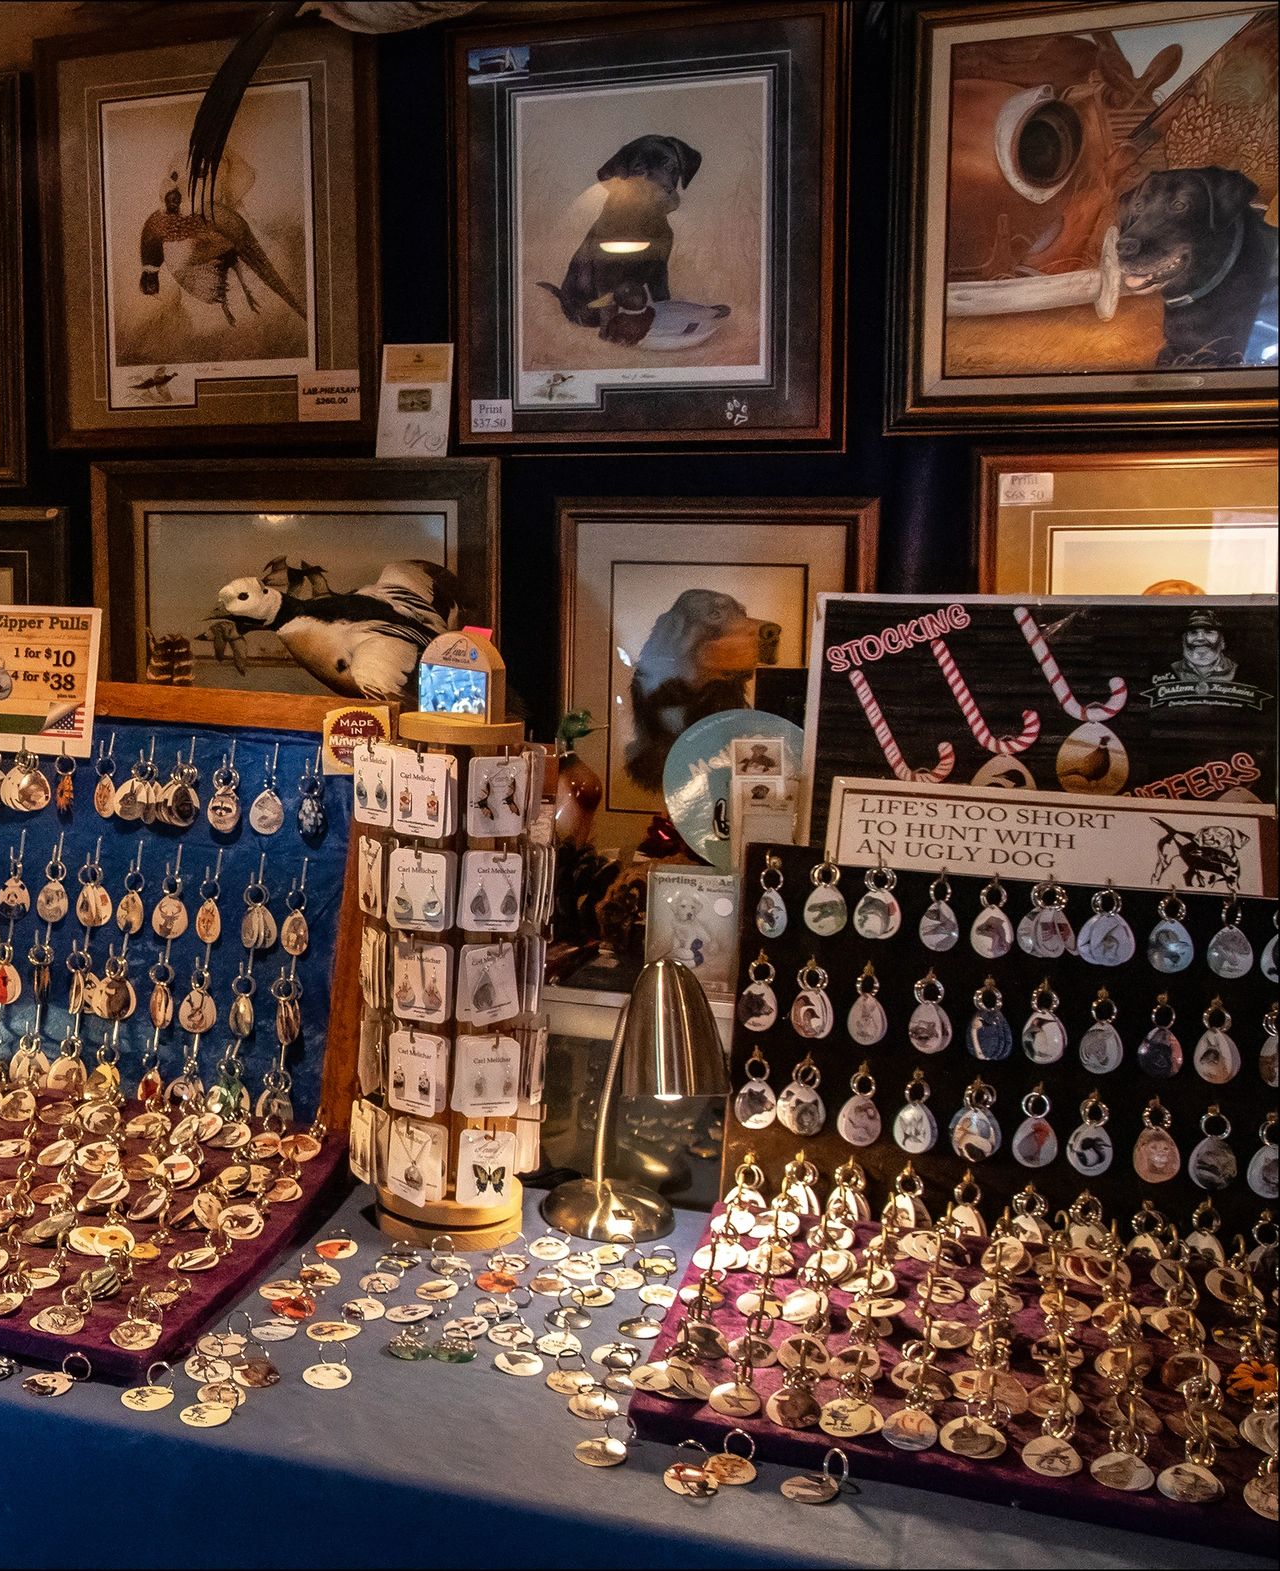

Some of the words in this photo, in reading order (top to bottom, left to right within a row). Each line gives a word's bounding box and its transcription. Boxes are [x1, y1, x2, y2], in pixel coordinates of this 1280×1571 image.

[478, 404, 503, 414] Print
[473, 418, 506, 429] $37.50
[48, 616, 88, 631] Pulls
[827, 604, 971, 672] STOCKING
[14, 647, 20, 658] 1
[24, 647, 41, 658] for
[44, 647, 76, 668] $10
[11, 671, 19, 681] 4
[22, 670, 39, 681] for
[42, 670, 75, 691] $38
[1157, 685, 1195, 697] Custom
[1210, 683, 1255, 698] Keychains
[339, 719, 374, 727] MADE
[399, 772, 412, 781] Carl
[858, 798, 938, 818] LIFE'S
[946, 803, 1008, 823] TOO
[1016, 808, 1116, 830] SHORT
[857, 819, 898, 836] TO
[905, 822, 987, 843] HUNT
[995, 829, 1076, 850] WITH
[855, 838, 896, 855] AN
[905, 842, 982, 862] UGLY
[989, 847, 1056, 868] DOG
[397, 1047, 409, 1055] Carl
